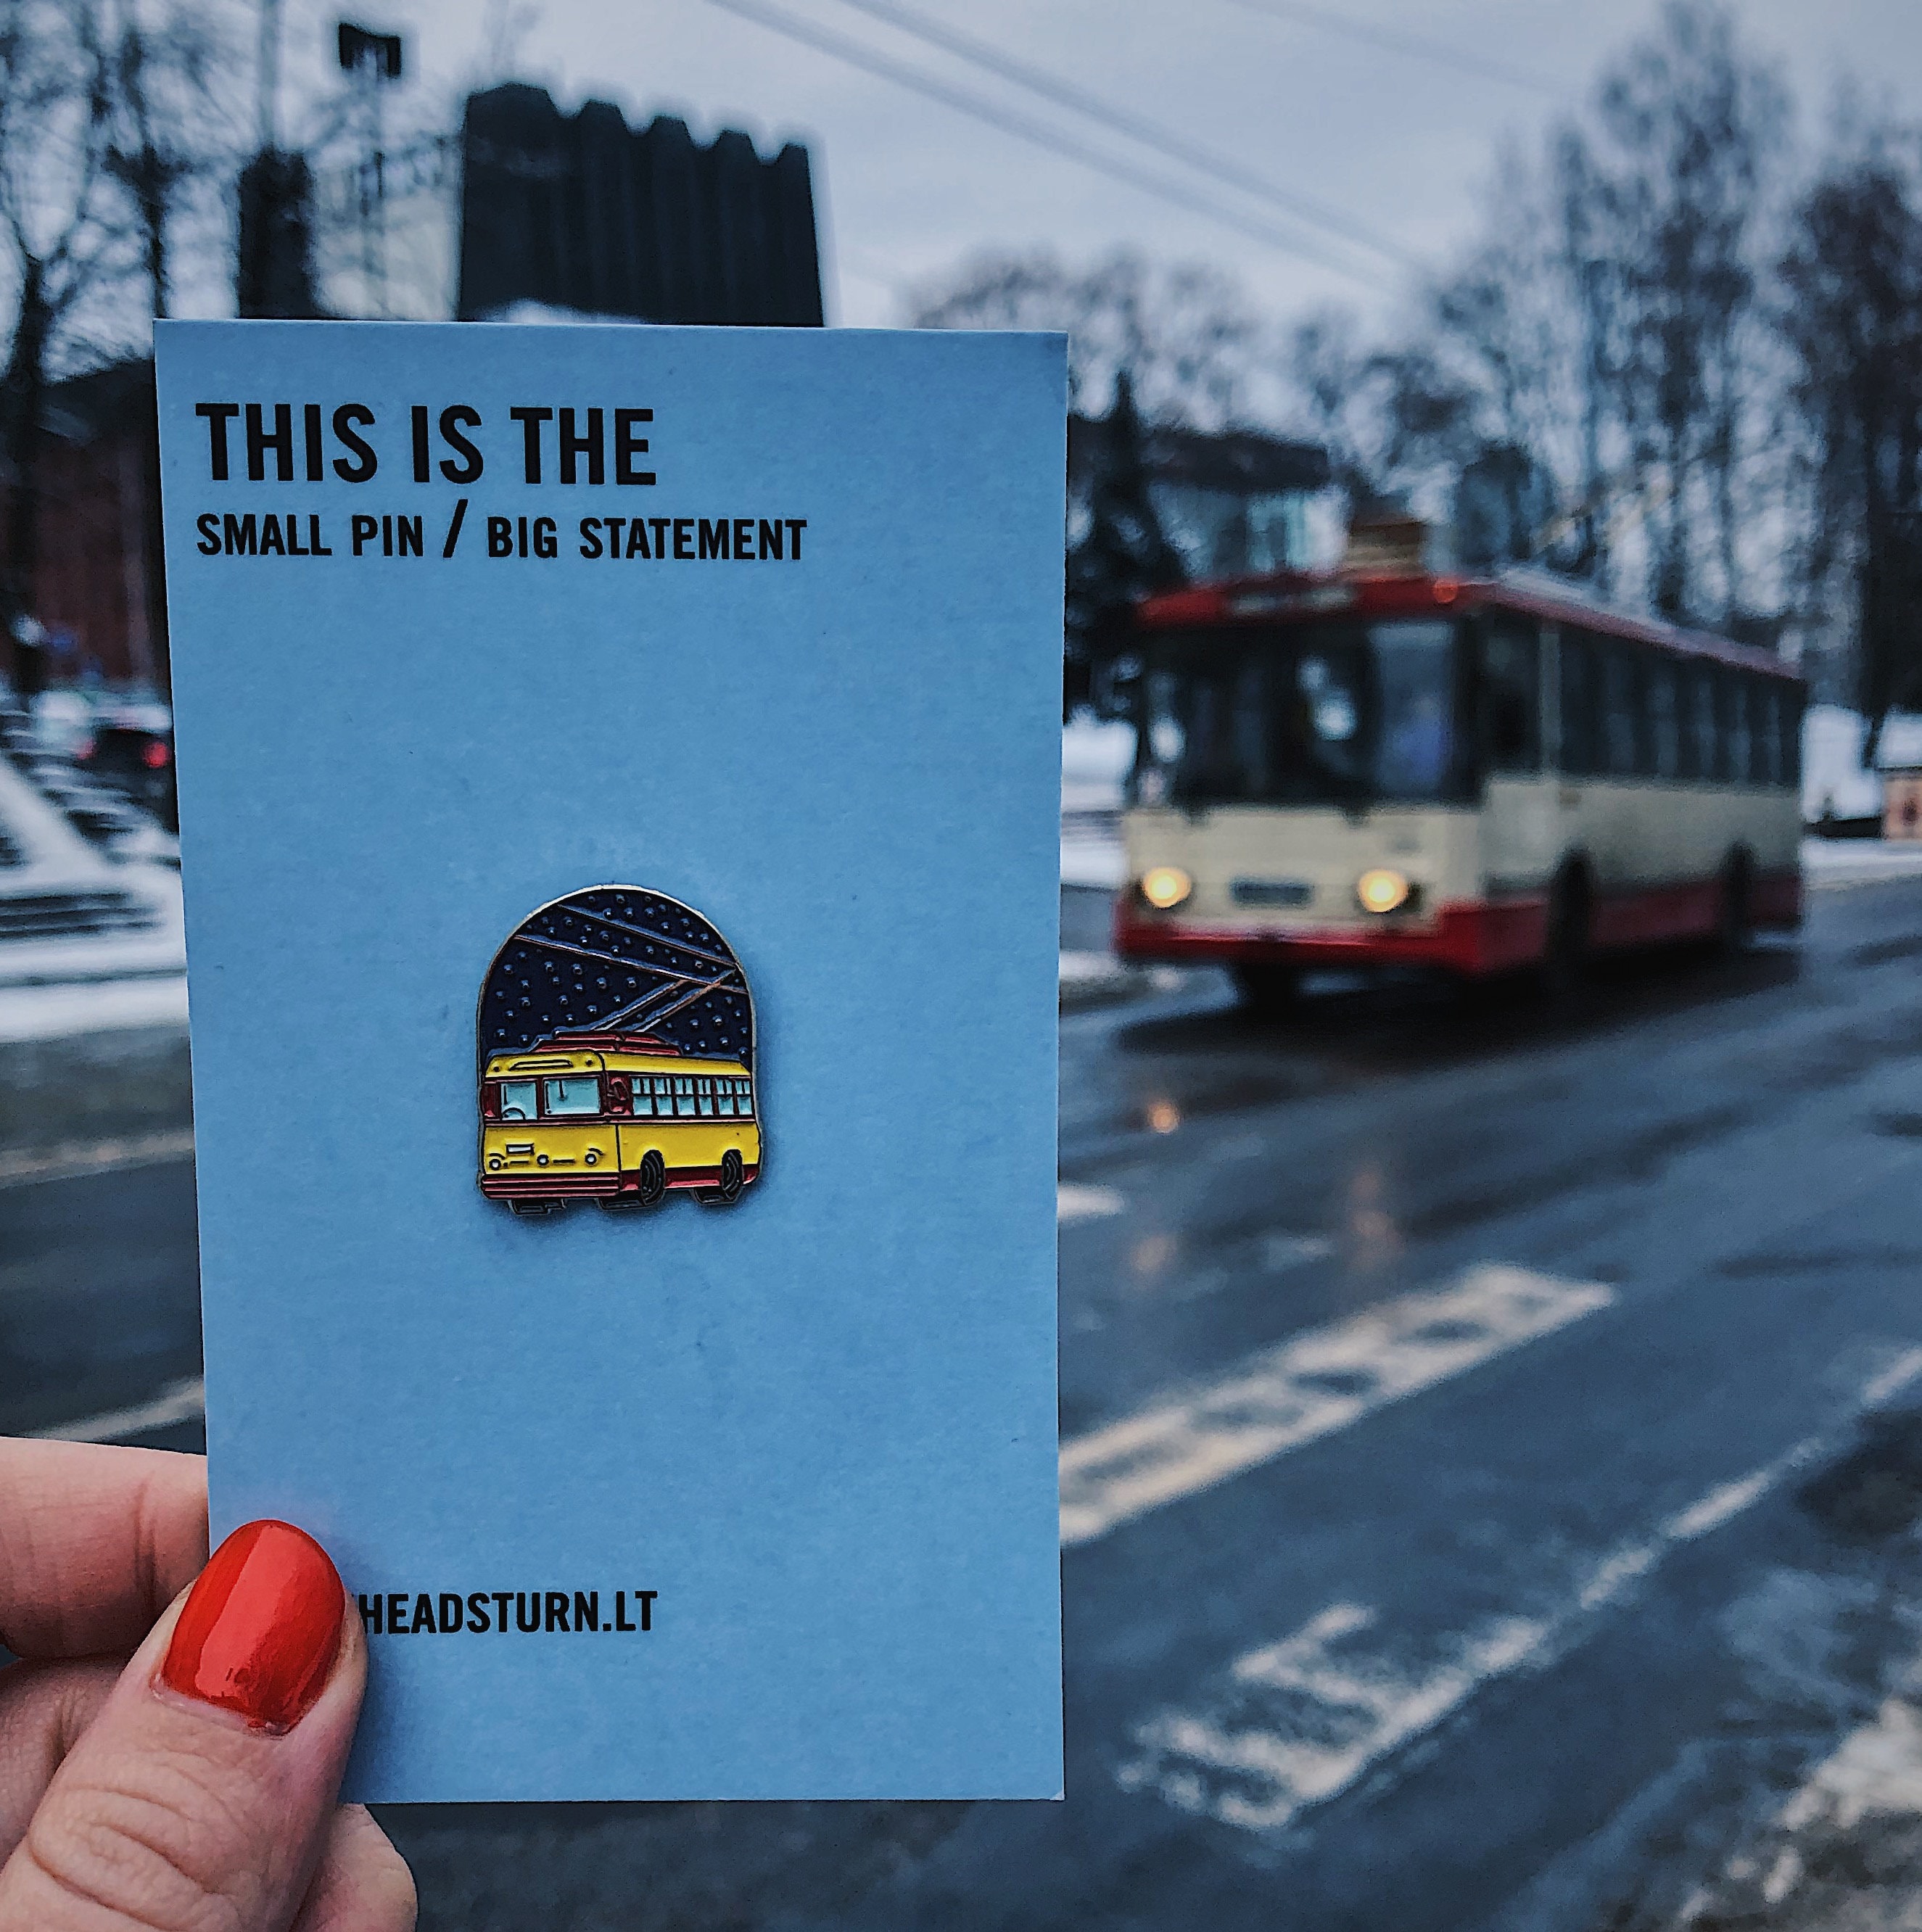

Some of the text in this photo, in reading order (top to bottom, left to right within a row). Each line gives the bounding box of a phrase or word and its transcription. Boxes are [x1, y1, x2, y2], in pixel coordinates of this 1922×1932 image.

[195, 402, 656, 486] THIS IS THE
[197, 498, 808, 561] SMALL PIN / BIG STATEMENT
[351, 1590, 659, 1635] HEADSTURN.LT
